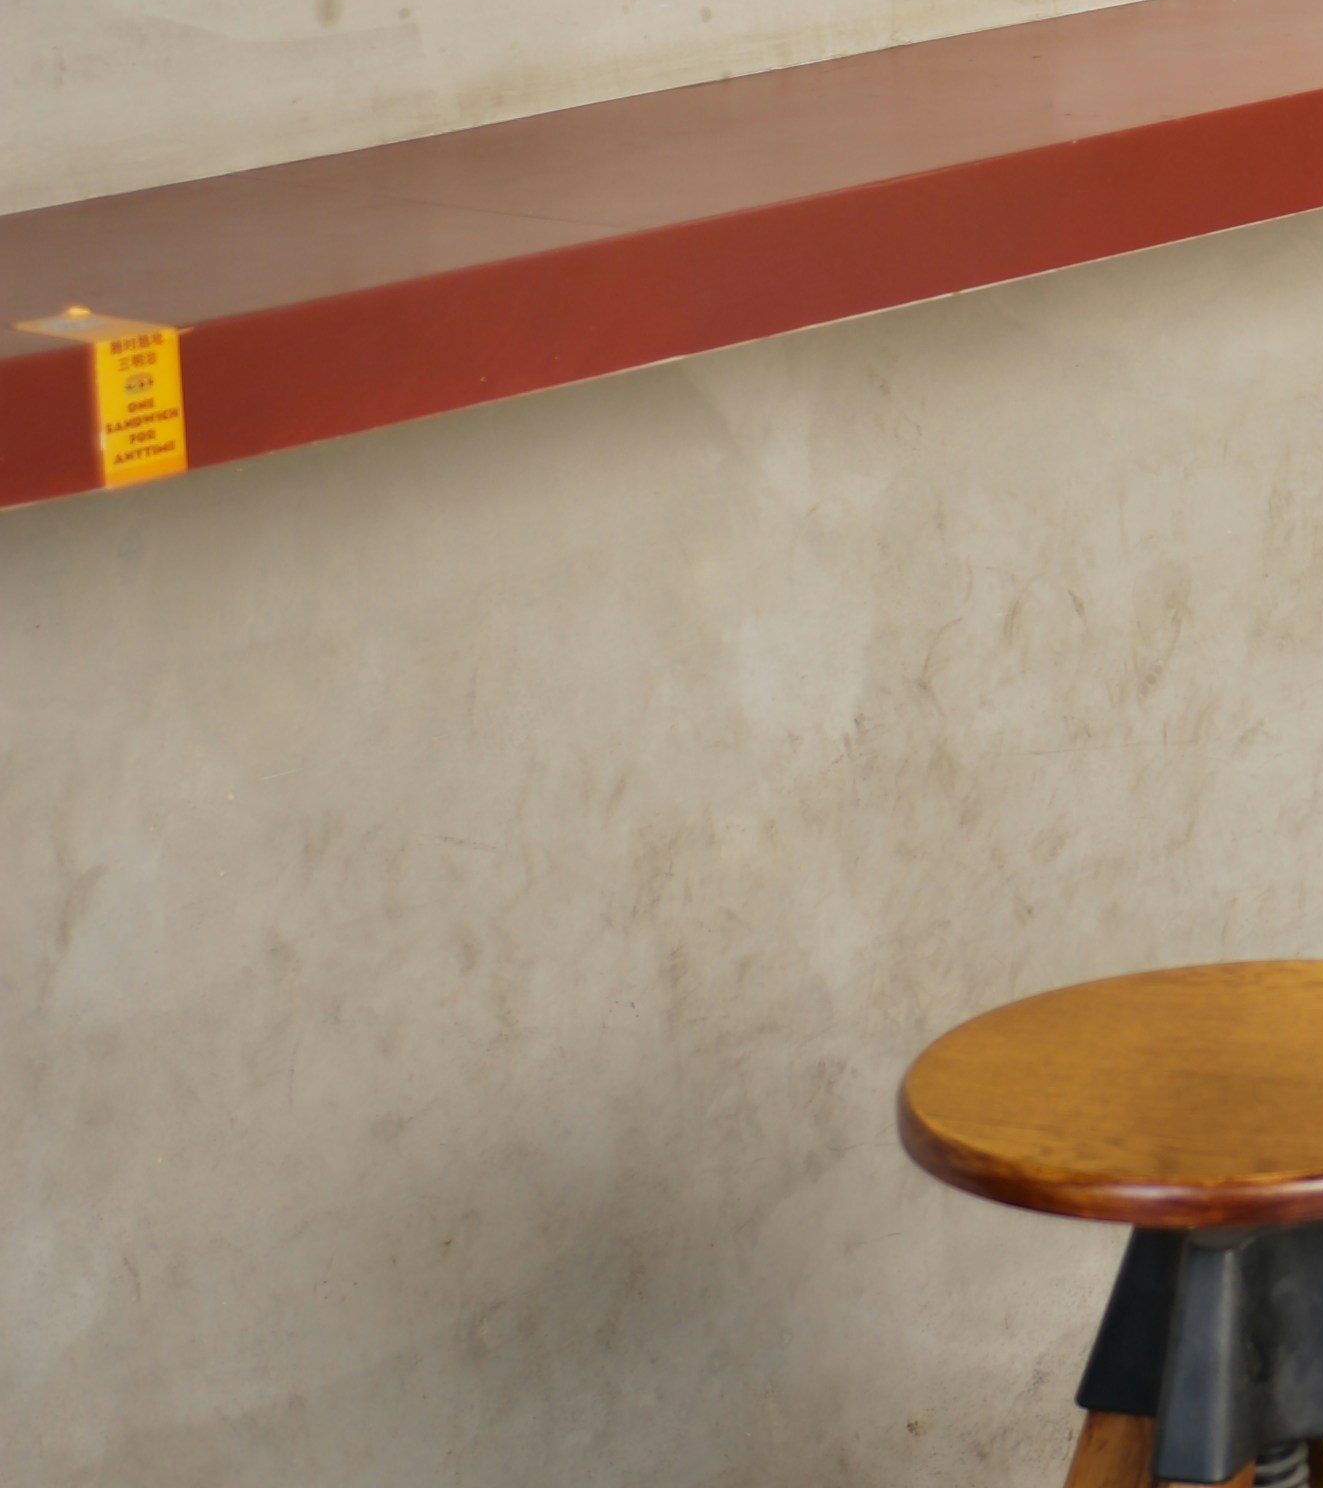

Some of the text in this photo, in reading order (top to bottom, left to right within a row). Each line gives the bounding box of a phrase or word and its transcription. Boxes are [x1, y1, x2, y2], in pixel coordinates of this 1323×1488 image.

[127, 398, 154, 413] ONE
[105, 408, 179, 434] SANDWICH
[129, 429, 156, 445] FOR
[113, 440, 175, 465] ANYTIME
